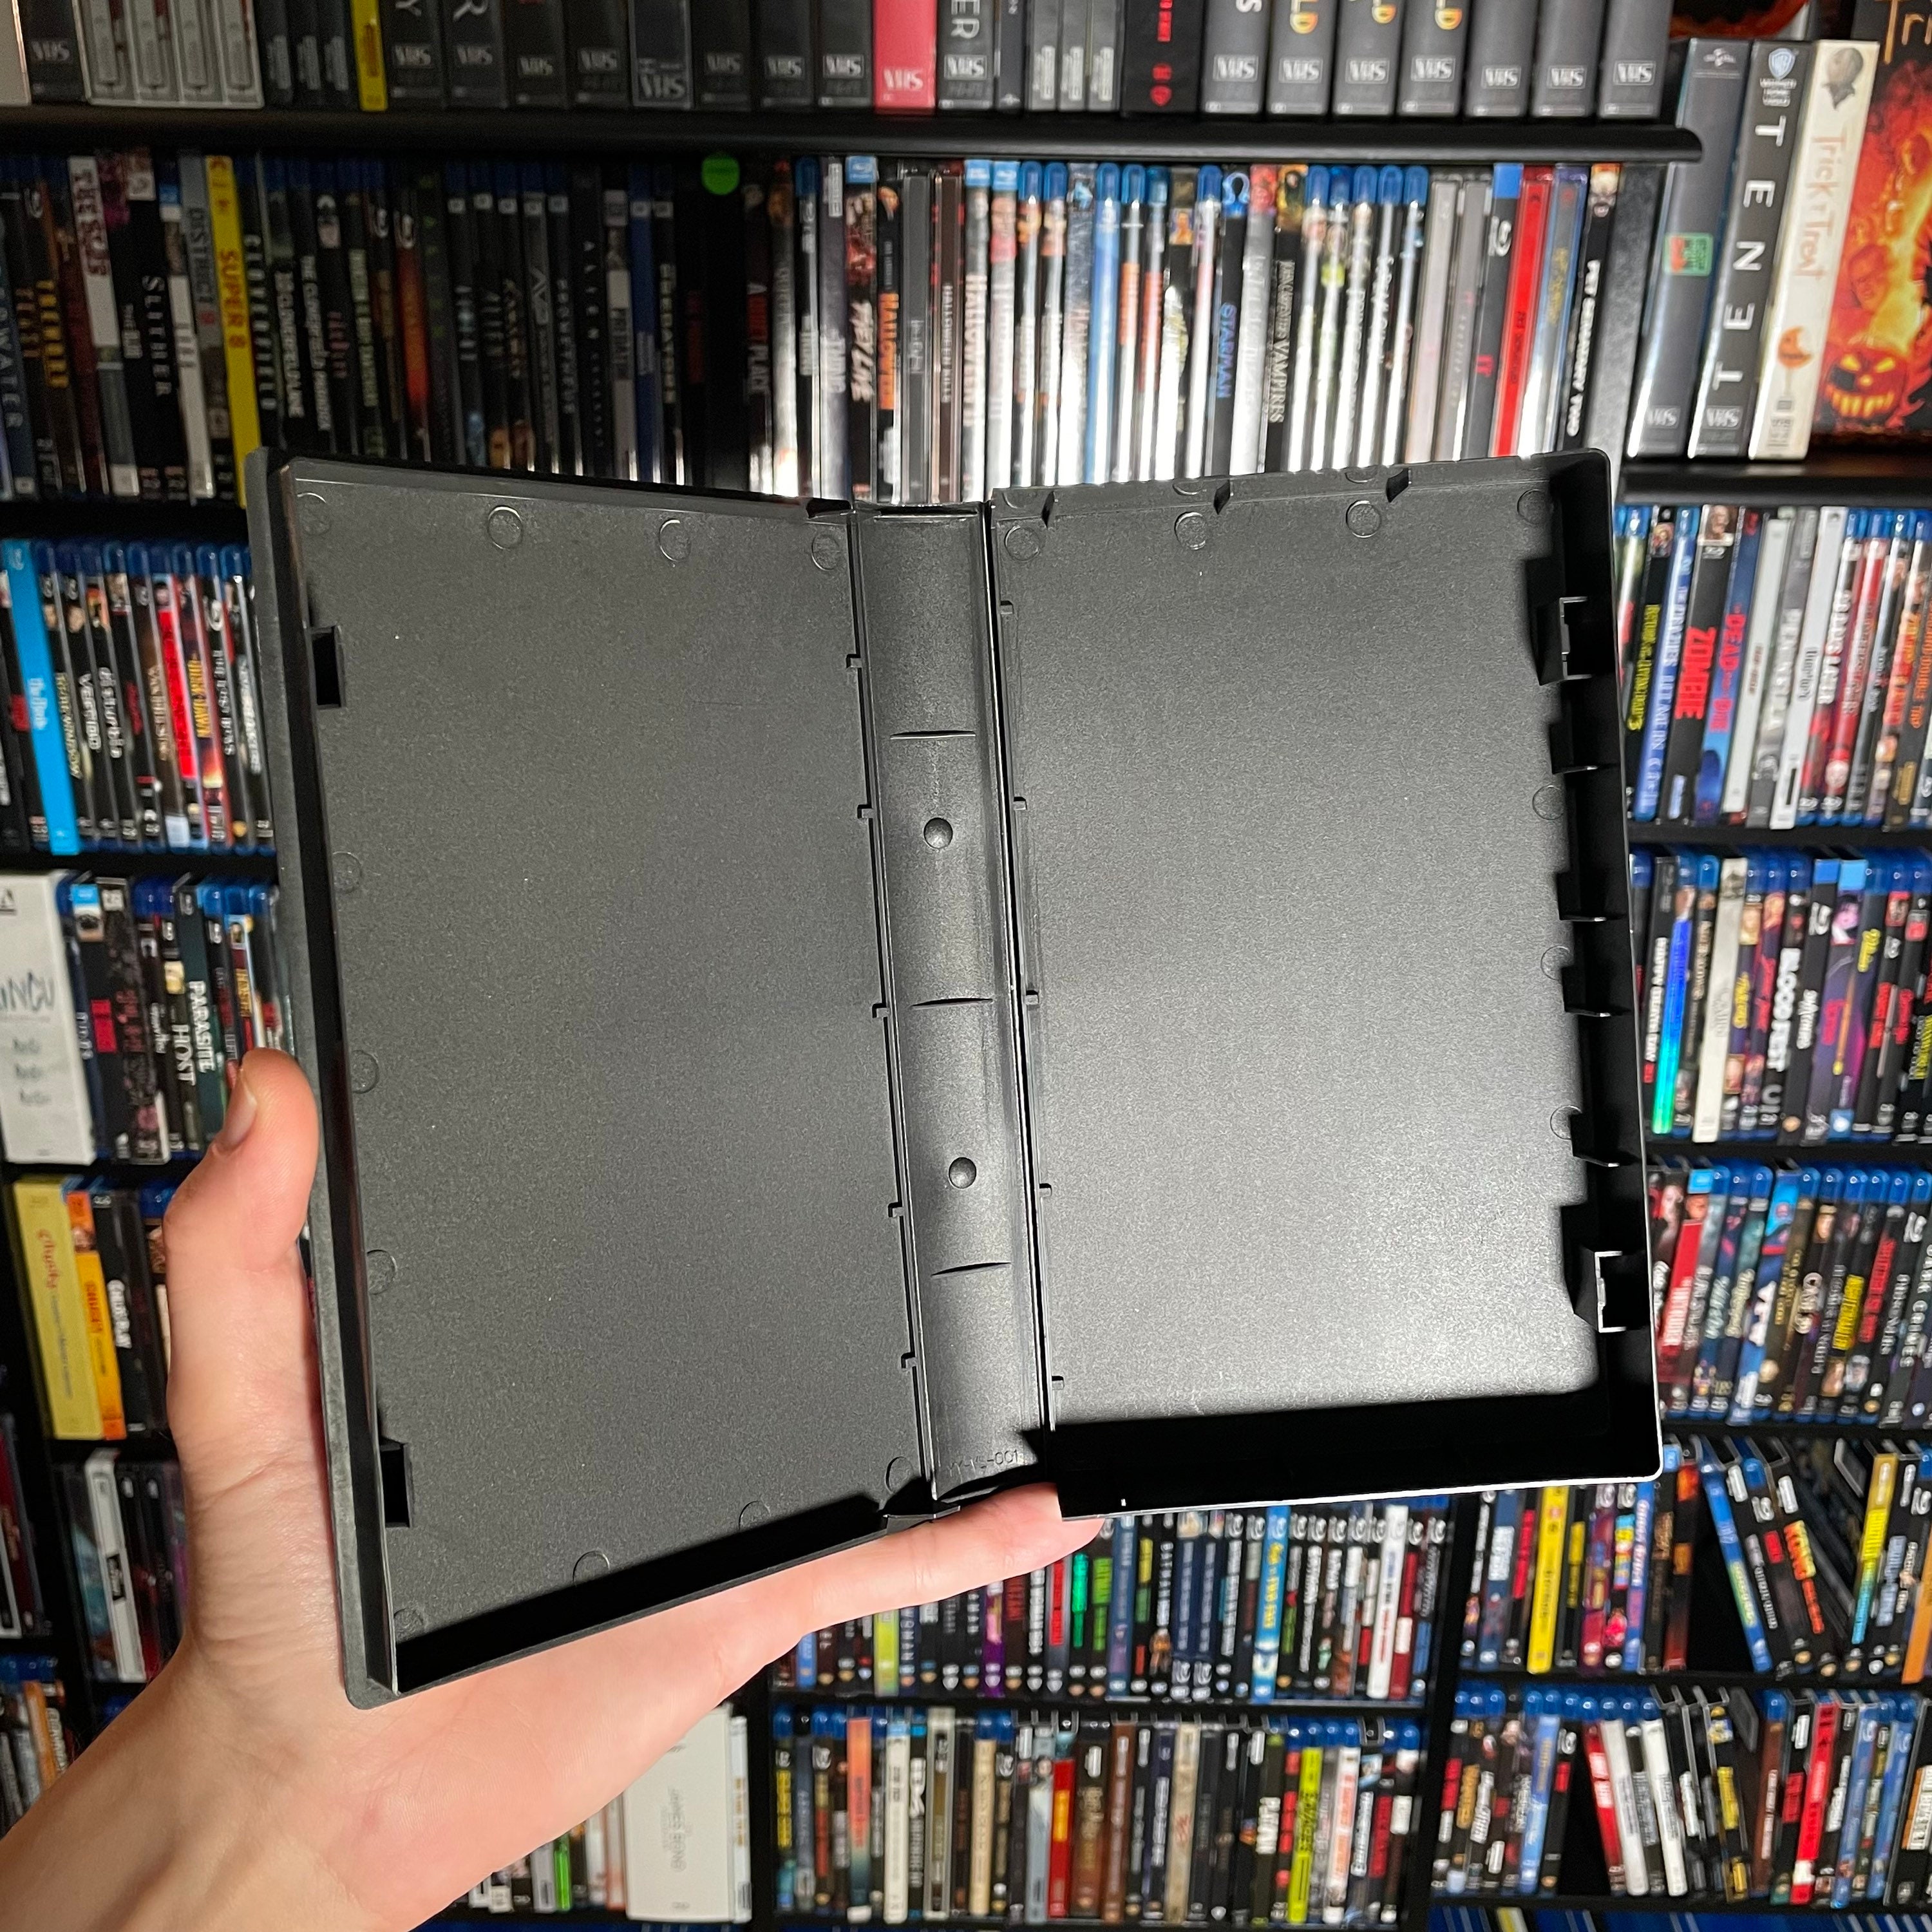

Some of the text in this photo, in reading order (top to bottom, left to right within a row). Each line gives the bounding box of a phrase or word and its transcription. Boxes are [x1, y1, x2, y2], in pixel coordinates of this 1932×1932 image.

[394, 45, 431, 64] VHS
[767, 59, 803, 77] VHS
[825, 56, 862, 76] VHS
[947, 56, 985, 77] VHS
[1217, 57, 1256, 80] VHS
[1282, 61, 1320, 81] VHS
[1349, 61, 1387, 82] VHS
[1415, 59, 1453, 80] VHS
[1617, 62, 1653, 84] VHS
[640, 72, 685, 98] VHS
[884, 69, 923, 91] VHS
[1484, 67, 1519, 88] VHS
[1551, 67, 1585, 88] VHS
[1806, 131, 1848, 197] Trick
[1712, 116, 1786, 390] TENET
[1793, 214, 1834, 280] Treat
[220, 250, 245, 328] SUPER
[142, 276, 173, 397] SLITHER
[941, 283, 953, 366] HALLOWEEN
[965, 274, 987, 404] HALLOWEEN
[1215, 302, 1238, 399] STARMAN
[1268, 340, 1290, 423] VAMPIRES
[1647, 408, 1678, 427] VHS
[1707, 408, 1739, 426] VHS
[1674, 627, 1716, 720] ZOMBIE
[1772, 947, 1802, 1020] BLOOD
[188, 980, 216, 1074] PARASITE
[1765, 1020, 1790, 1072] FEST
[171, 1023, 196, 1086] HOST
[1899, 1299, 1927, 1368] CRIMES
